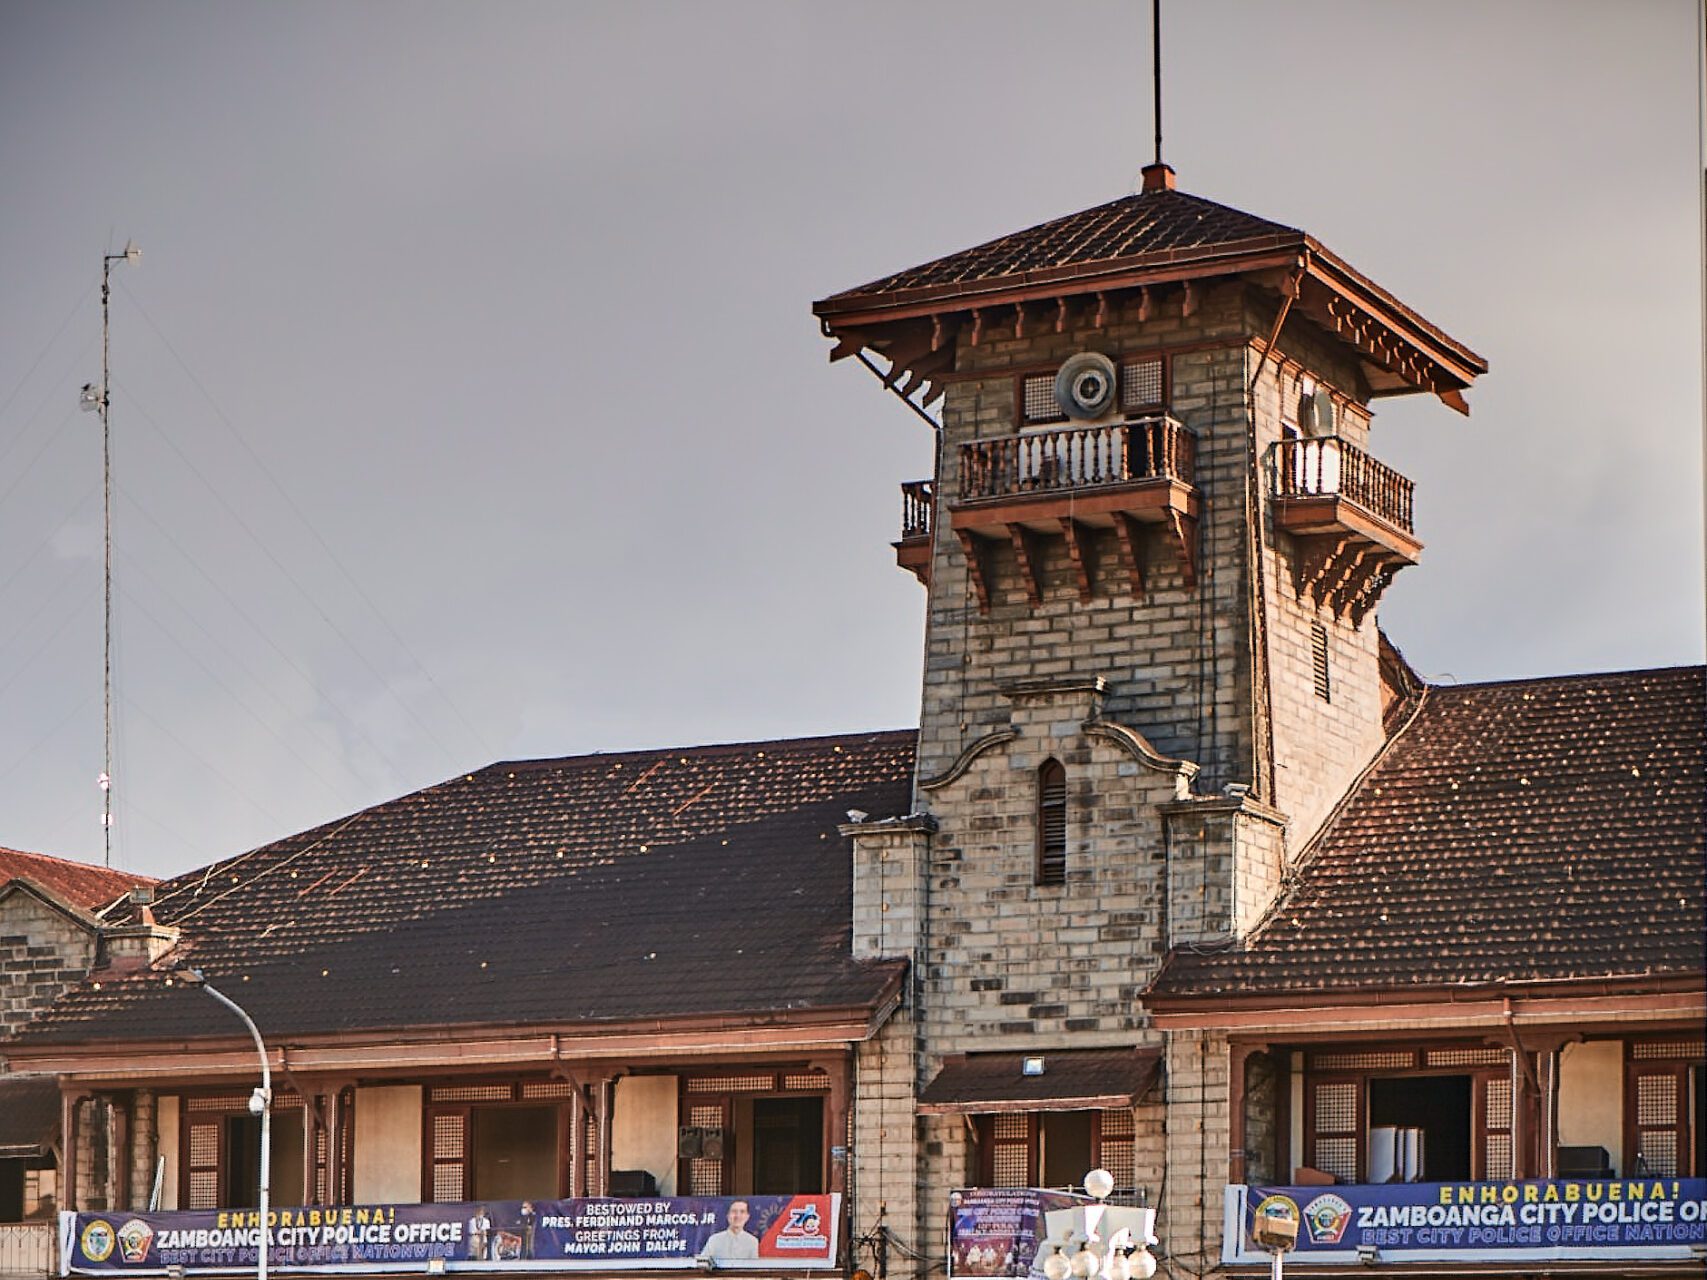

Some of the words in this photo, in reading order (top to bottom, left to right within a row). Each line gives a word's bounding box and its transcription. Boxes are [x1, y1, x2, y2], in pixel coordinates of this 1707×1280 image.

[1439, 1182, 1679, 1204] ENHORABUENA!
[217, 1208, 395, 1229] ENHORABUENA!
[587, 1203, 652, 1215] BESTOWED
[655, 1202, 671, 1213] BY
[1358, 1204, 1516, 1227] ZAMBOANGA
[1520, 1203, 1578, 1225] CITY
[1583, 1201, 1674, 1223] POLICE
[542, 1216, 574, 1228] PRES.
[576, 1215, 643, 1227] FERDINAND
[646, 1214, 699, 1226] MARCOS,
[277, 1227, 321, 1246] CITY
[322, 1224, 390, 1244] POLICE
[394, 1222, 462, 1242] OFFICE
[575, 1230, 640, 1242] GREETINGS
[643, 1228, 679, 1240] FROM:
[1362, 1228, 1413, 1244] BEST
[1417, 1227, 1464, 1244] CITY
[1468, 1226, 1541, 1243] POLICE
[1547, 1224, 1619, 1242] OFFICE
[160, 1249, 198, 1264] BEST
[201, 1249, 237, 1263] CITY
[352, 1243, 455, 1259] NATIONWIDE
[565, 1242, 607, 1254] MAYOR
[607, 1241, 640, 1252] JOHN
[646, 1240, 687, 1252] DALIPE
